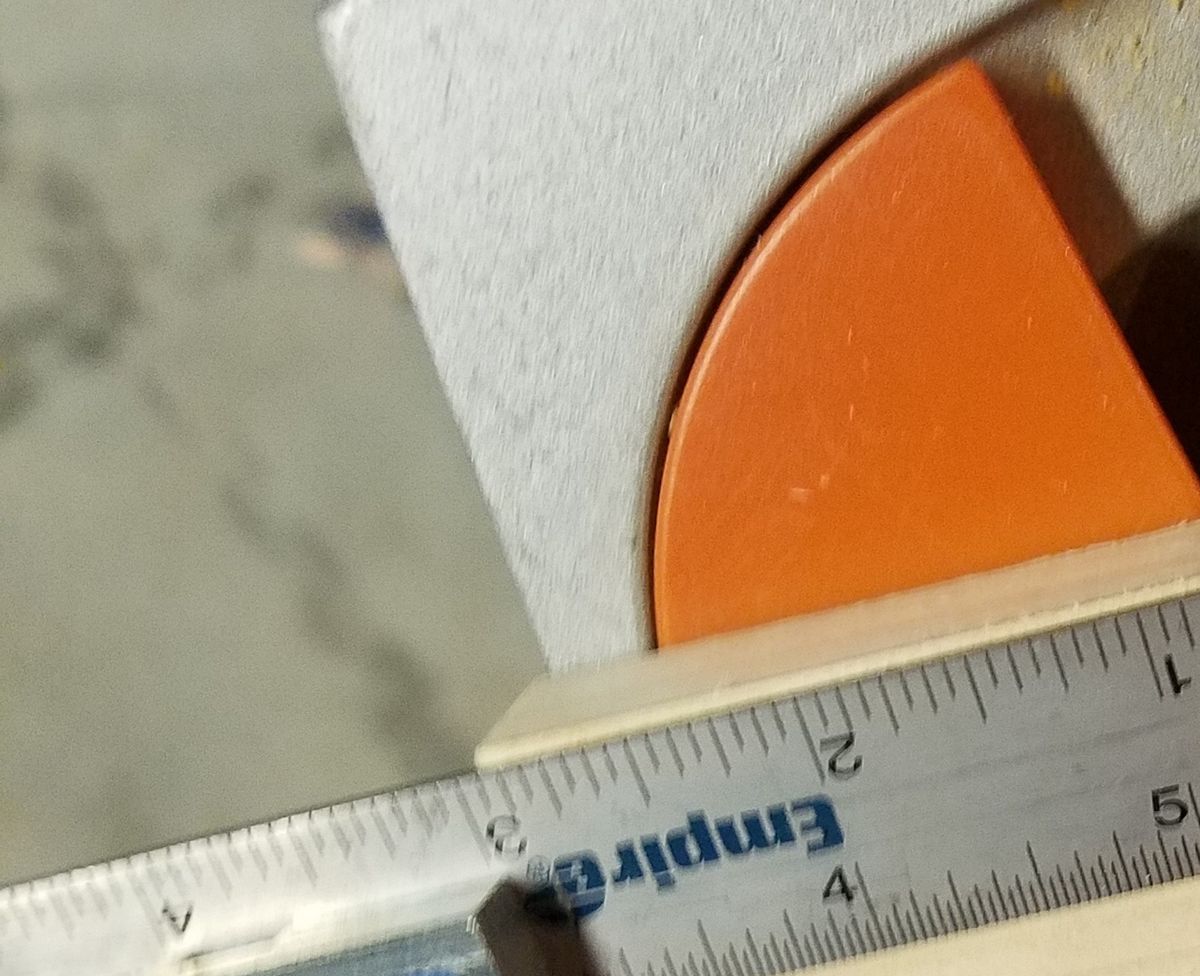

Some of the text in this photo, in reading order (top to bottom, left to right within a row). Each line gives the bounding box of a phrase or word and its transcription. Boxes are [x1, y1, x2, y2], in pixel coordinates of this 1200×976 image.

[1164, 652, 1192, 694] 1
[819, 732, 863, 781] 2
[1151, 784, 1189, 827] 5
[486, 814, 528, 856] 3
[553, 792, 845, 917] Empire
[822, 864, 858, 902] 4
